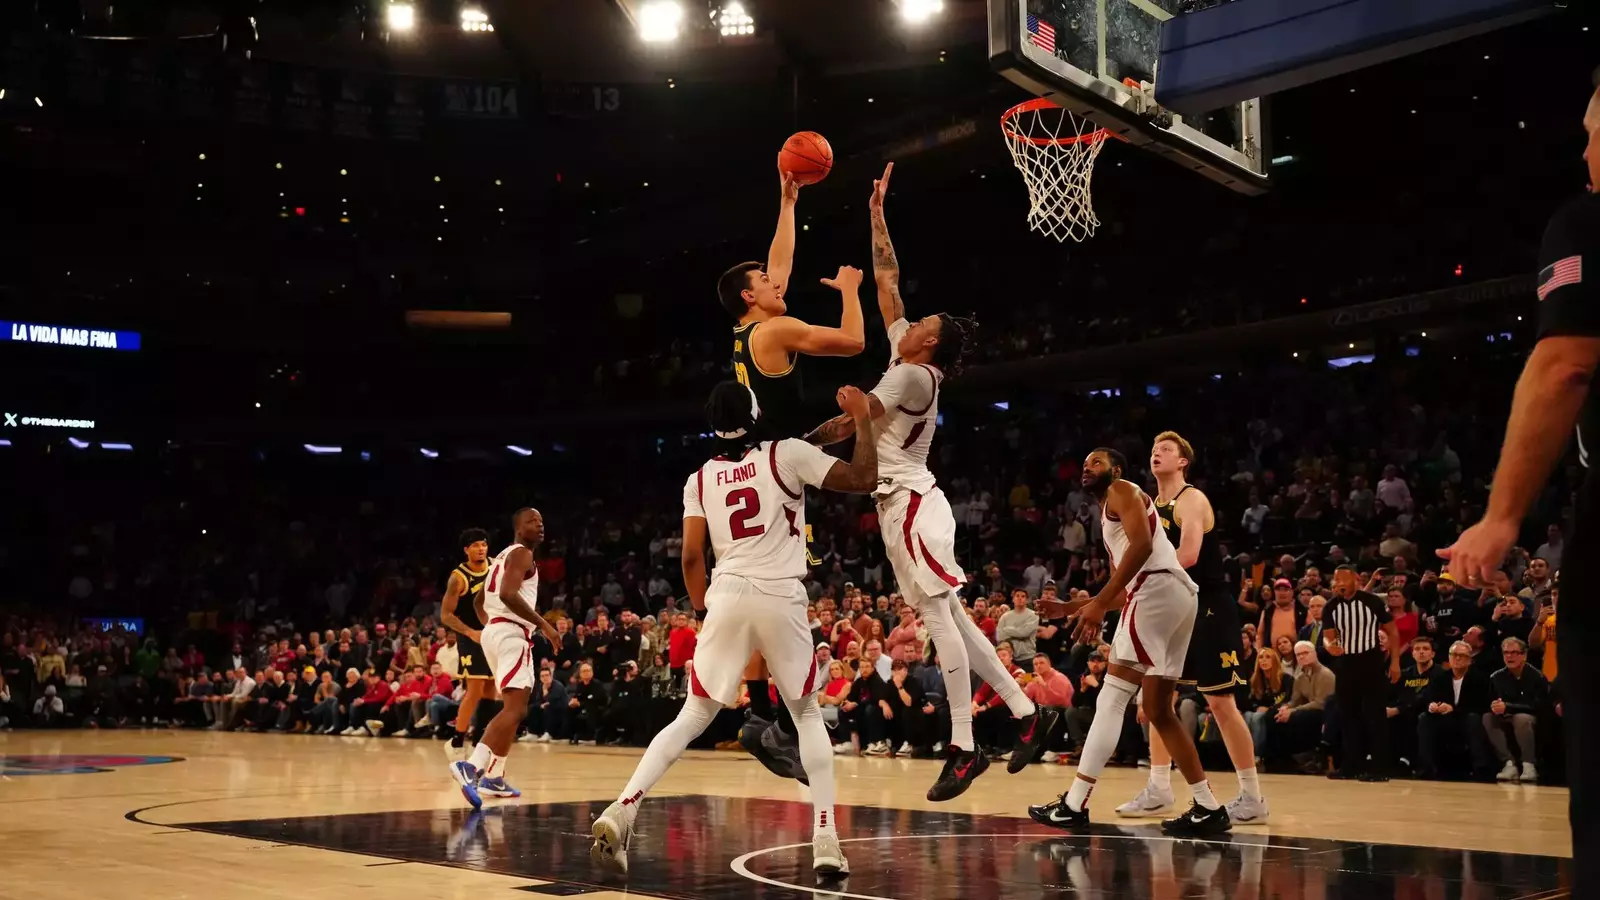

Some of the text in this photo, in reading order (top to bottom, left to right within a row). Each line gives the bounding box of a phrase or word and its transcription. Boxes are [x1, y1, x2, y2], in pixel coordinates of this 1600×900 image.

[473, 85, 518, 114] 104
[592, 85, 620, 111] 13
[12, 323, 118, 349] LA VIDA MAS FINA
[717, 462, 757, 487] FLAND
[725, 486, 765, 541] 2
[460, 654, 473, 667] M
[1220, 650, 1240, 668] M
